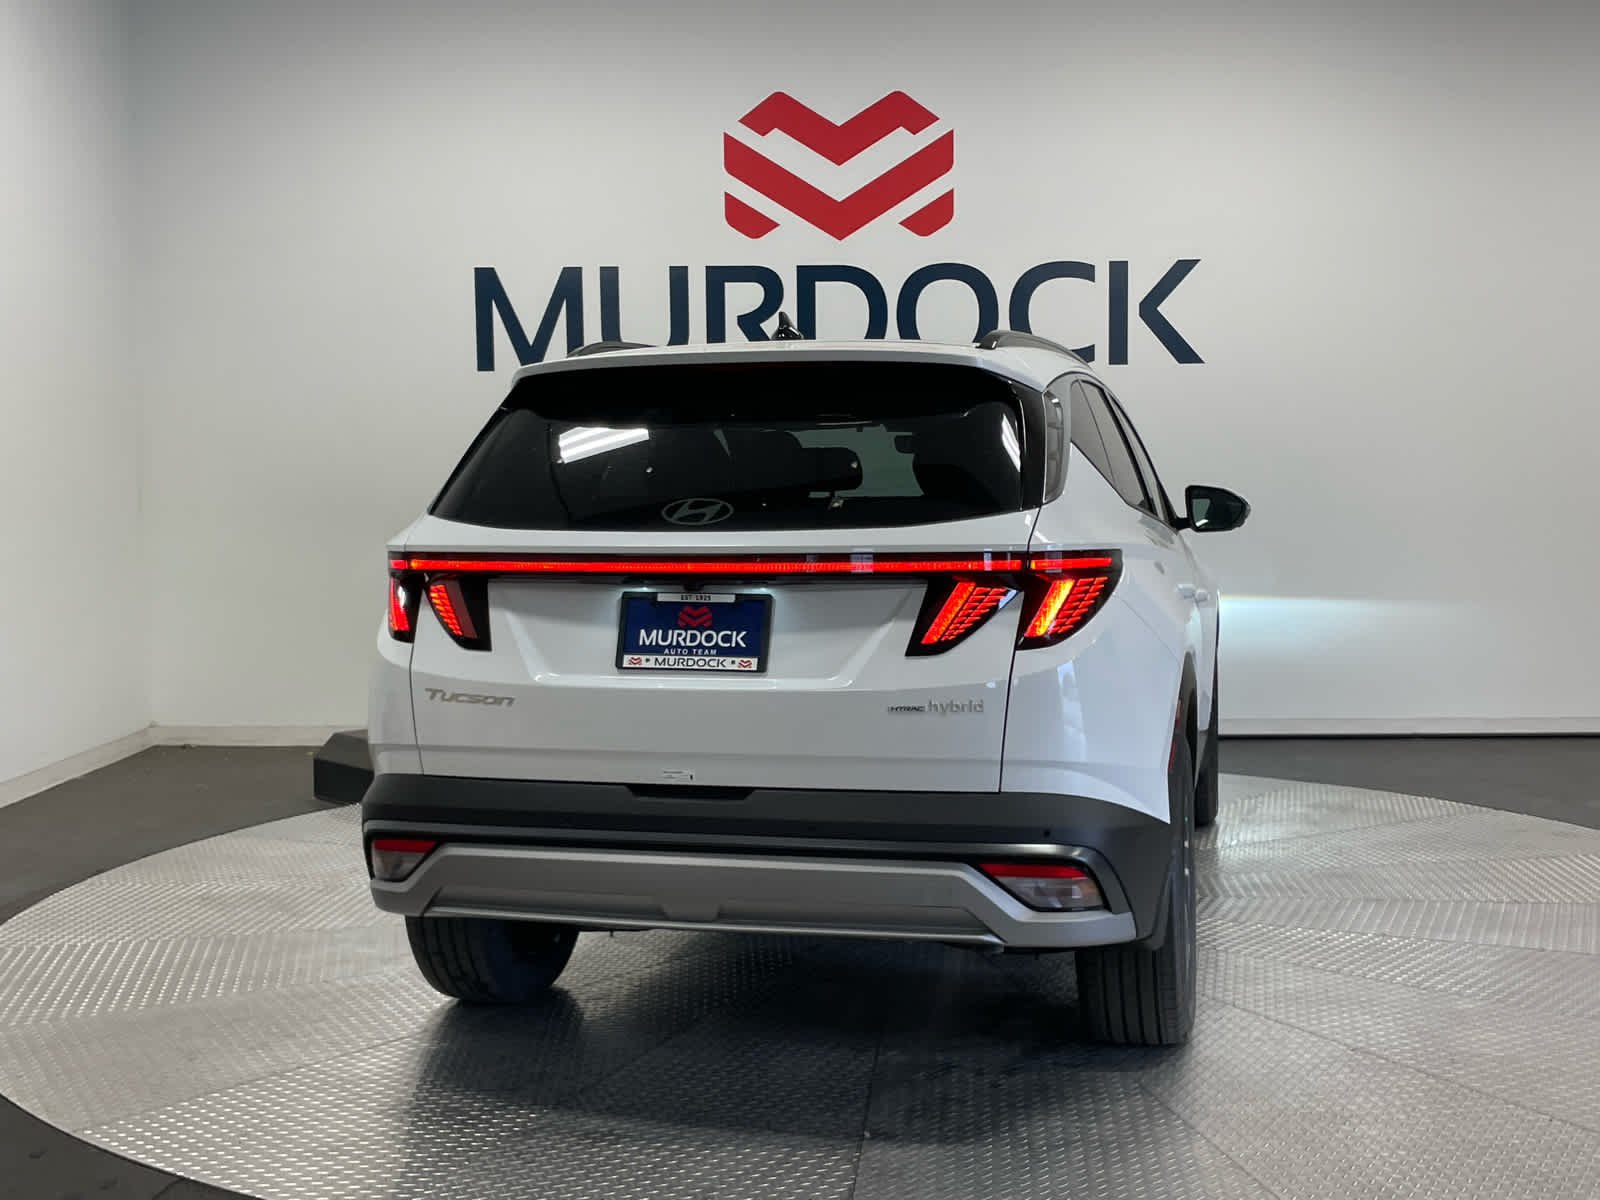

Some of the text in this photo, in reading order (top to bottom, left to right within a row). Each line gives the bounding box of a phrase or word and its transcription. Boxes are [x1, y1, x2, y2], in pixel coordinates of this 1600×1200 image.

[474, 258, 1205, 372] MURDOCK
[638, 629, 748, 647] MURDOCK
[654, 657, 727, 668] MURDOCK
[928, 699, 984, 716] hybrid
